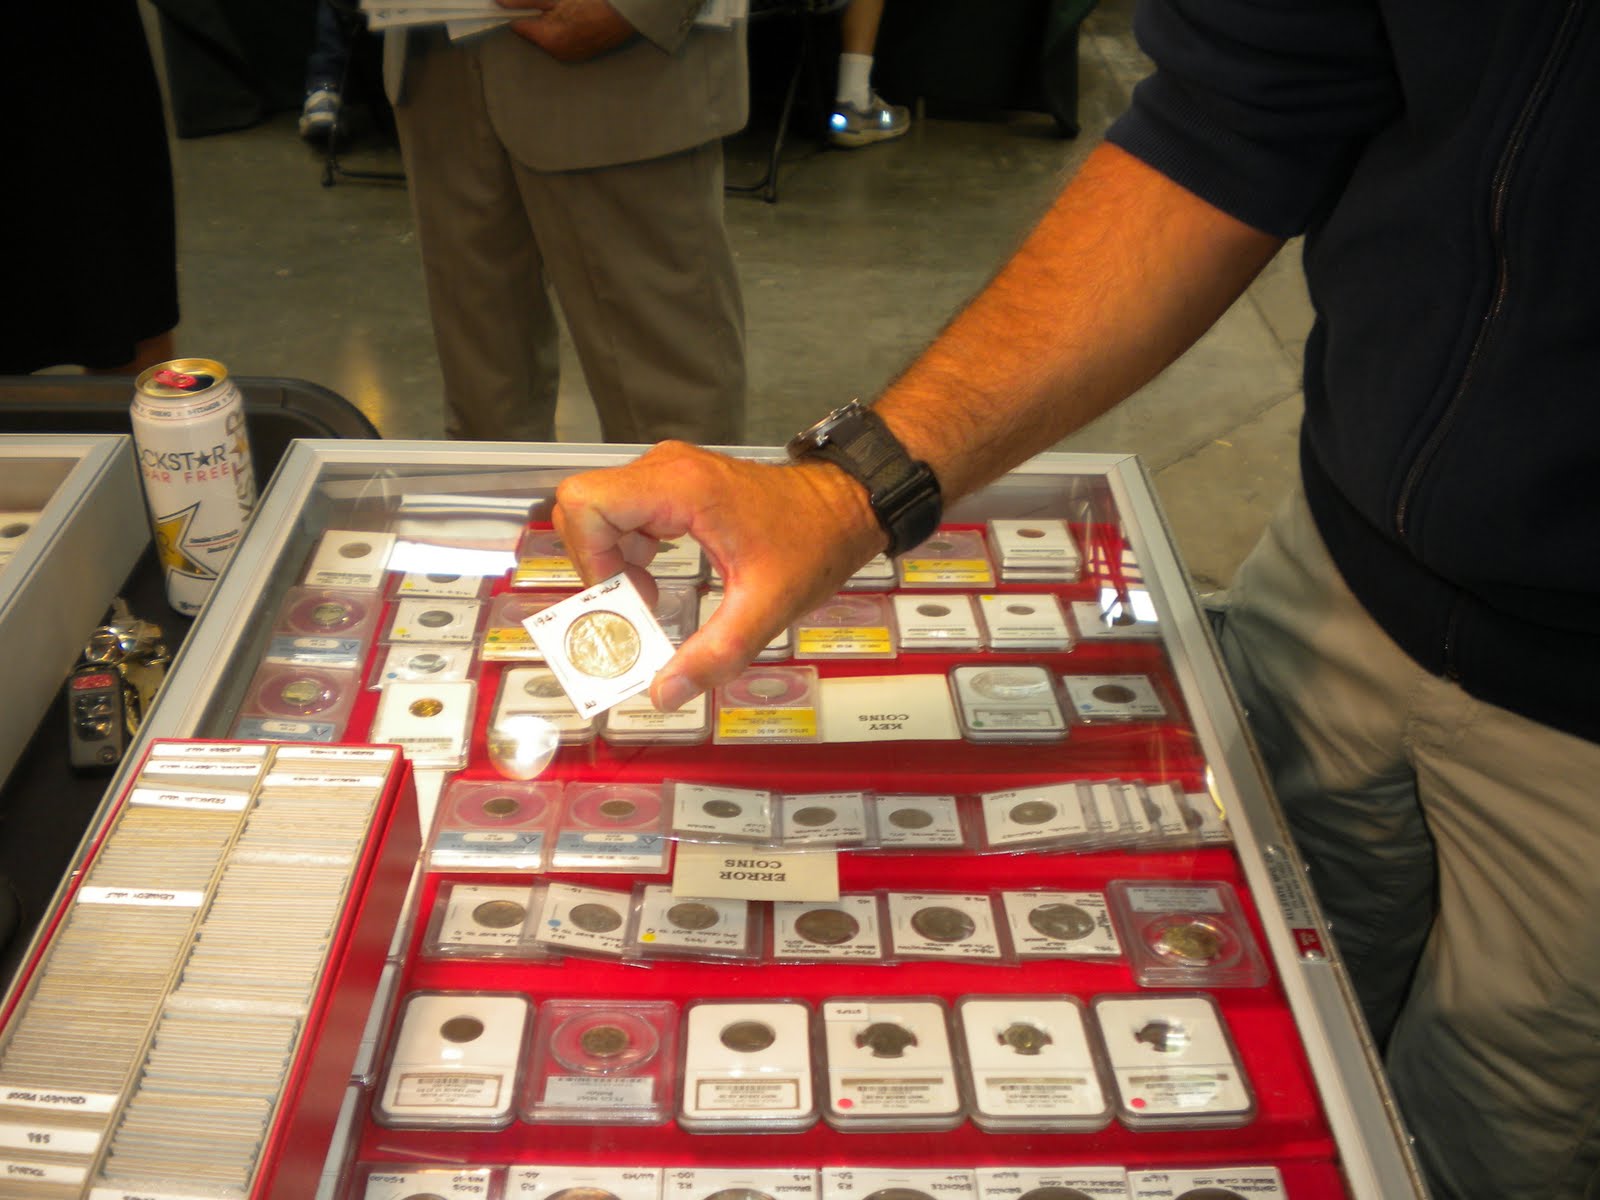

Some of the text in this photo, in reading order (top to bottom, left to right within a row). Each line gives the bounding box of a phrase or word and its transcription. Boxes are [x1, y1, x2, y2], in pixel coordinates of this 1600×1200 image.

[183, 463, 230, 483] FREE
[858, 714, 910, 722] COINS
[868, 723, 903, 731] KEY
[724, 859, 782, 870] COINS
[719, 871, 786, 882] ERROR
[132, 892, 176, 900] KENNEDY
[930, 1183, 972, 1191] BRONZE
